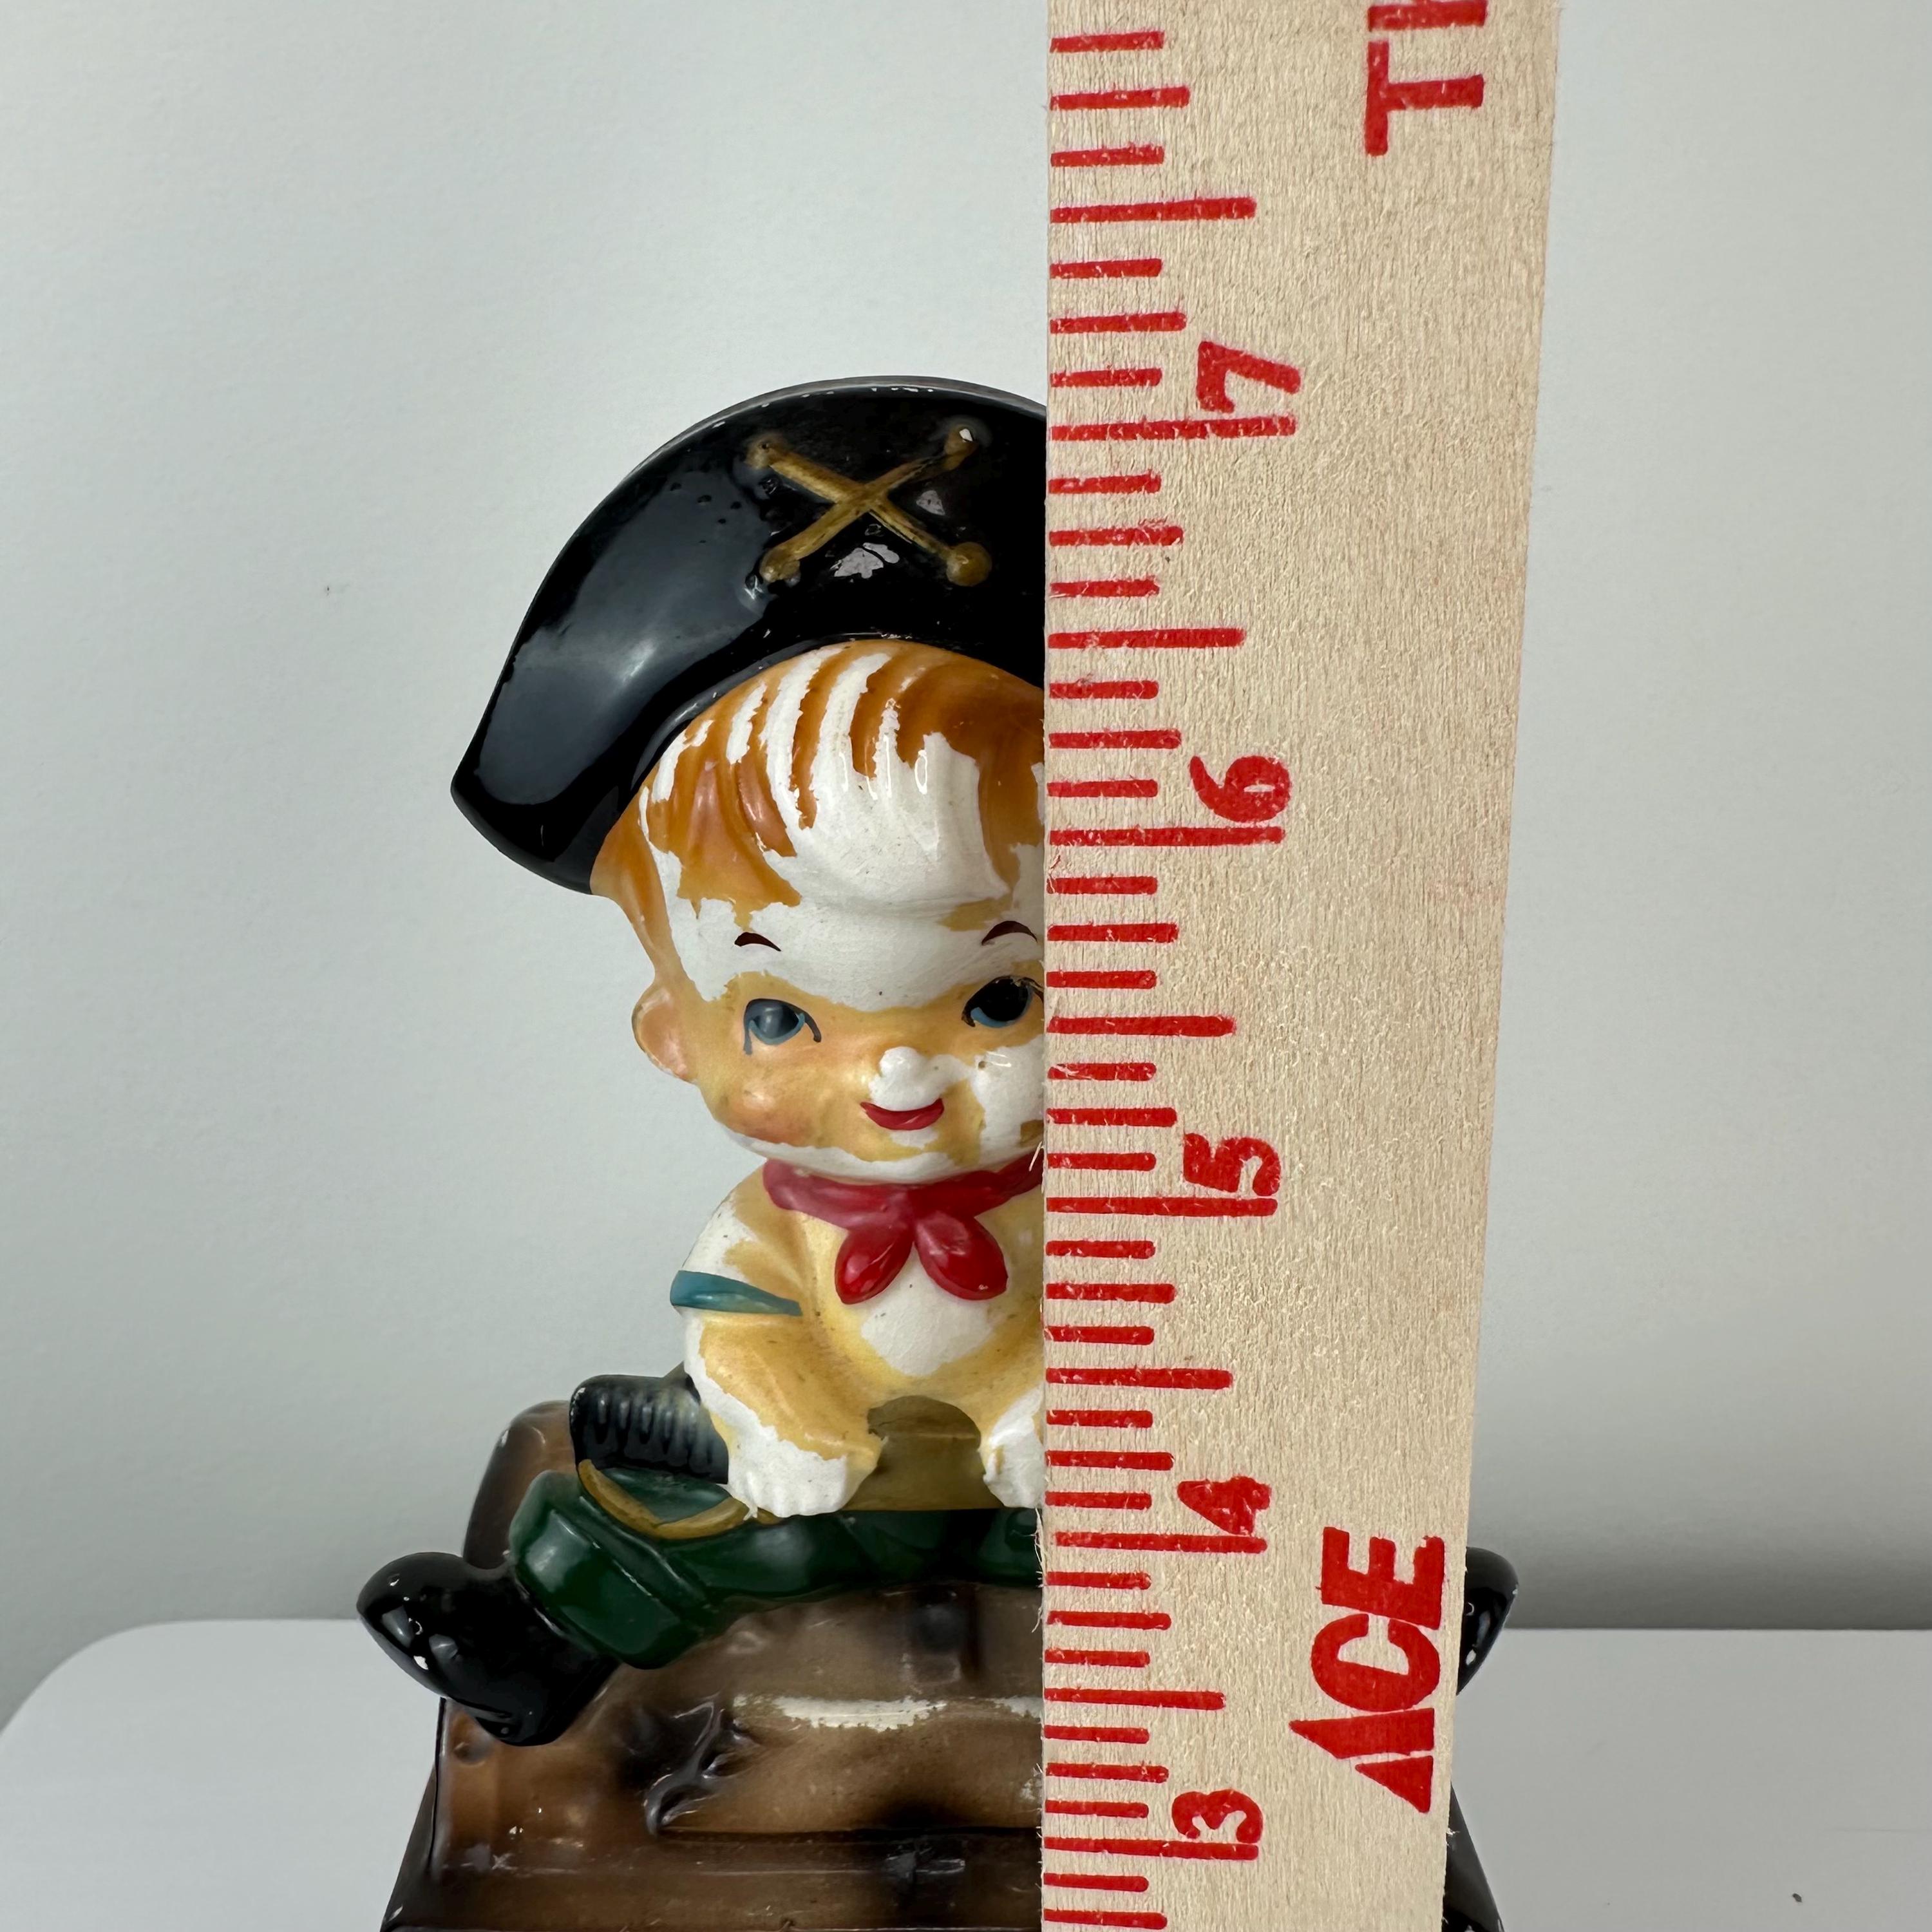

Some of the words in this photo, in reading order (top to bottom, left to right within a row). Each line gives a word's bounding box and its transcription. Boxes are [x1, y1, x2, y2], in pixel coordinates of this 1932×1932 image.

[1195, 341, 1301, 413] 7
[1189, 755, 1291, 823] 6
[1182, 1132, 1282, 1197] 5
[1177, 1475, 1272, 1536] 4
[1288, 1526, 1446, 1814] ACE
[1171, 1788, 1264, 1843] 3
